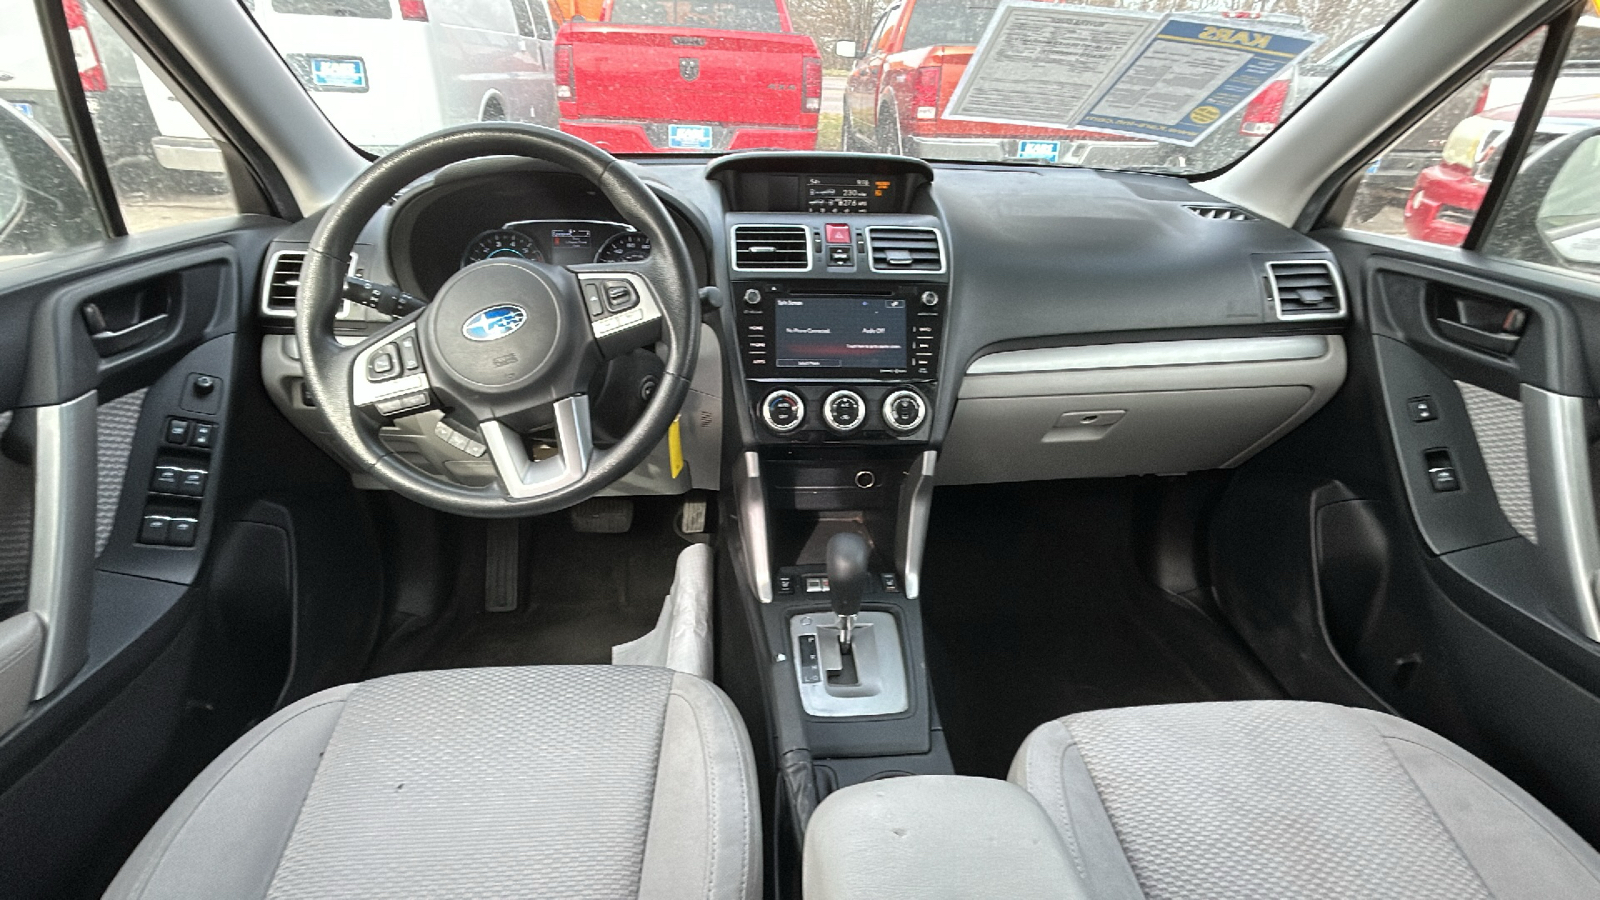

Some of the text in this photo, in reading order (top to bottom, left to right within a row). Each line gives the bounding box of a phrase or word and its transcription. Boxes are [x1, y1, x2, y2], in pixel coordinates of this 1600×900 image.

[320, 61, 355, 76] KARS
[676, 127, 704, 140] KARS
[1025, 143, 1054, 156] KARS
